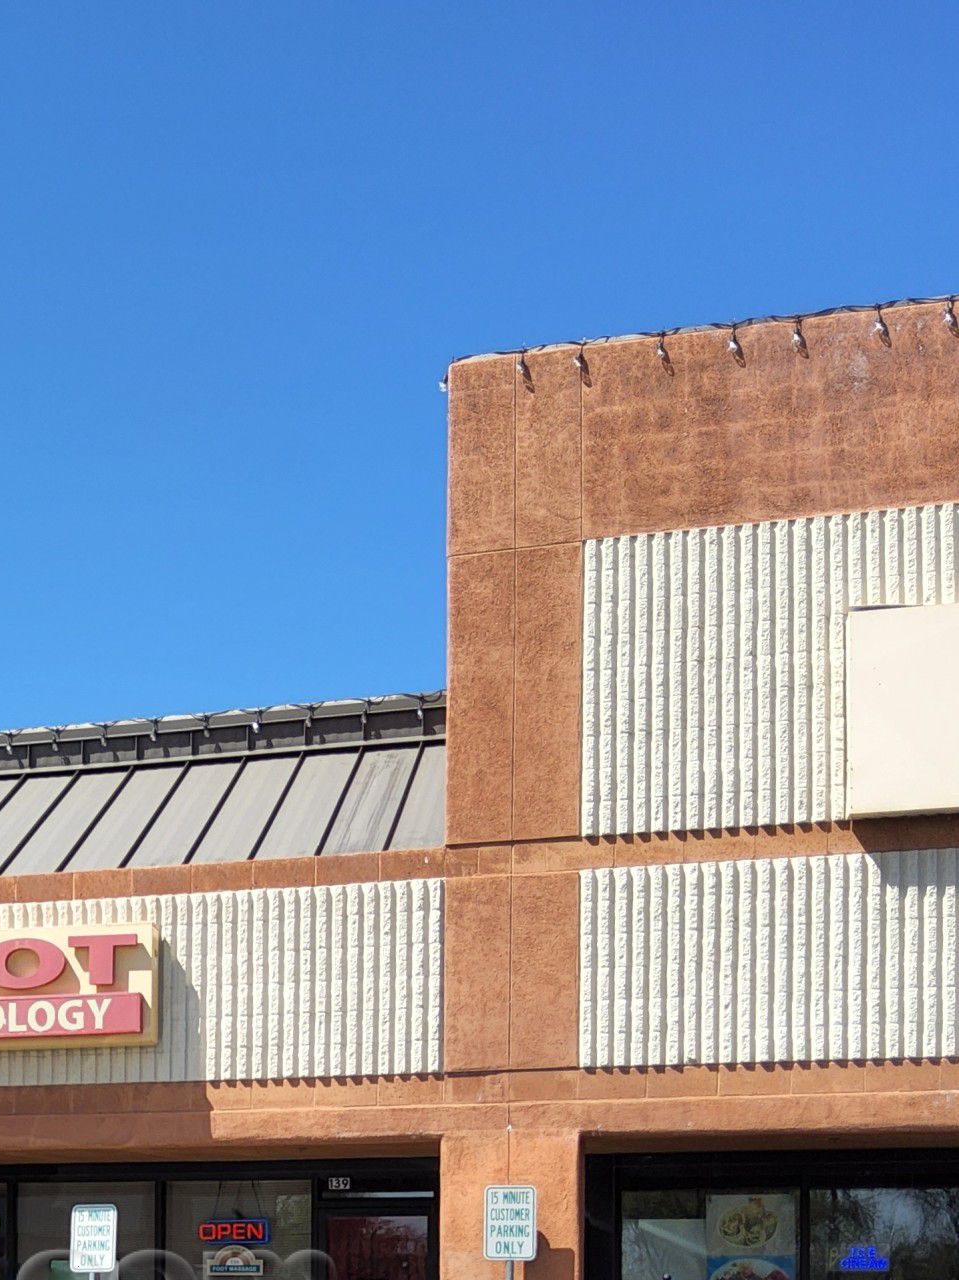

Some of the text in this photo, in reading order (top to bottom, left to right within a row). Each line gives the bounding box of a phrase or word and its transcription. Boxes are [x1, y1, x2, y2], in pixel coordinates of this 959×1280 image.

[329, 1177, 350, 1189] 139
[491, 1191, 530, 1204] 15 MINUTE
[78, 1210, 111, 1222] 15 MINUTE
[490, 1208, 530, 1221] CUSTOMER
[77, 1225, 111, 1237] CUSTOMER
[199, 1223, 264, 1240] OPEN
[490, 1224, 530, 1238] PARKING
[76, 1239, 111, 1252] PARKING
[495, 1240, 524, 1255] ONLY
[851, 1246, 876, 1258] ICE
[80, 1254, 105, 1267] ONLY
